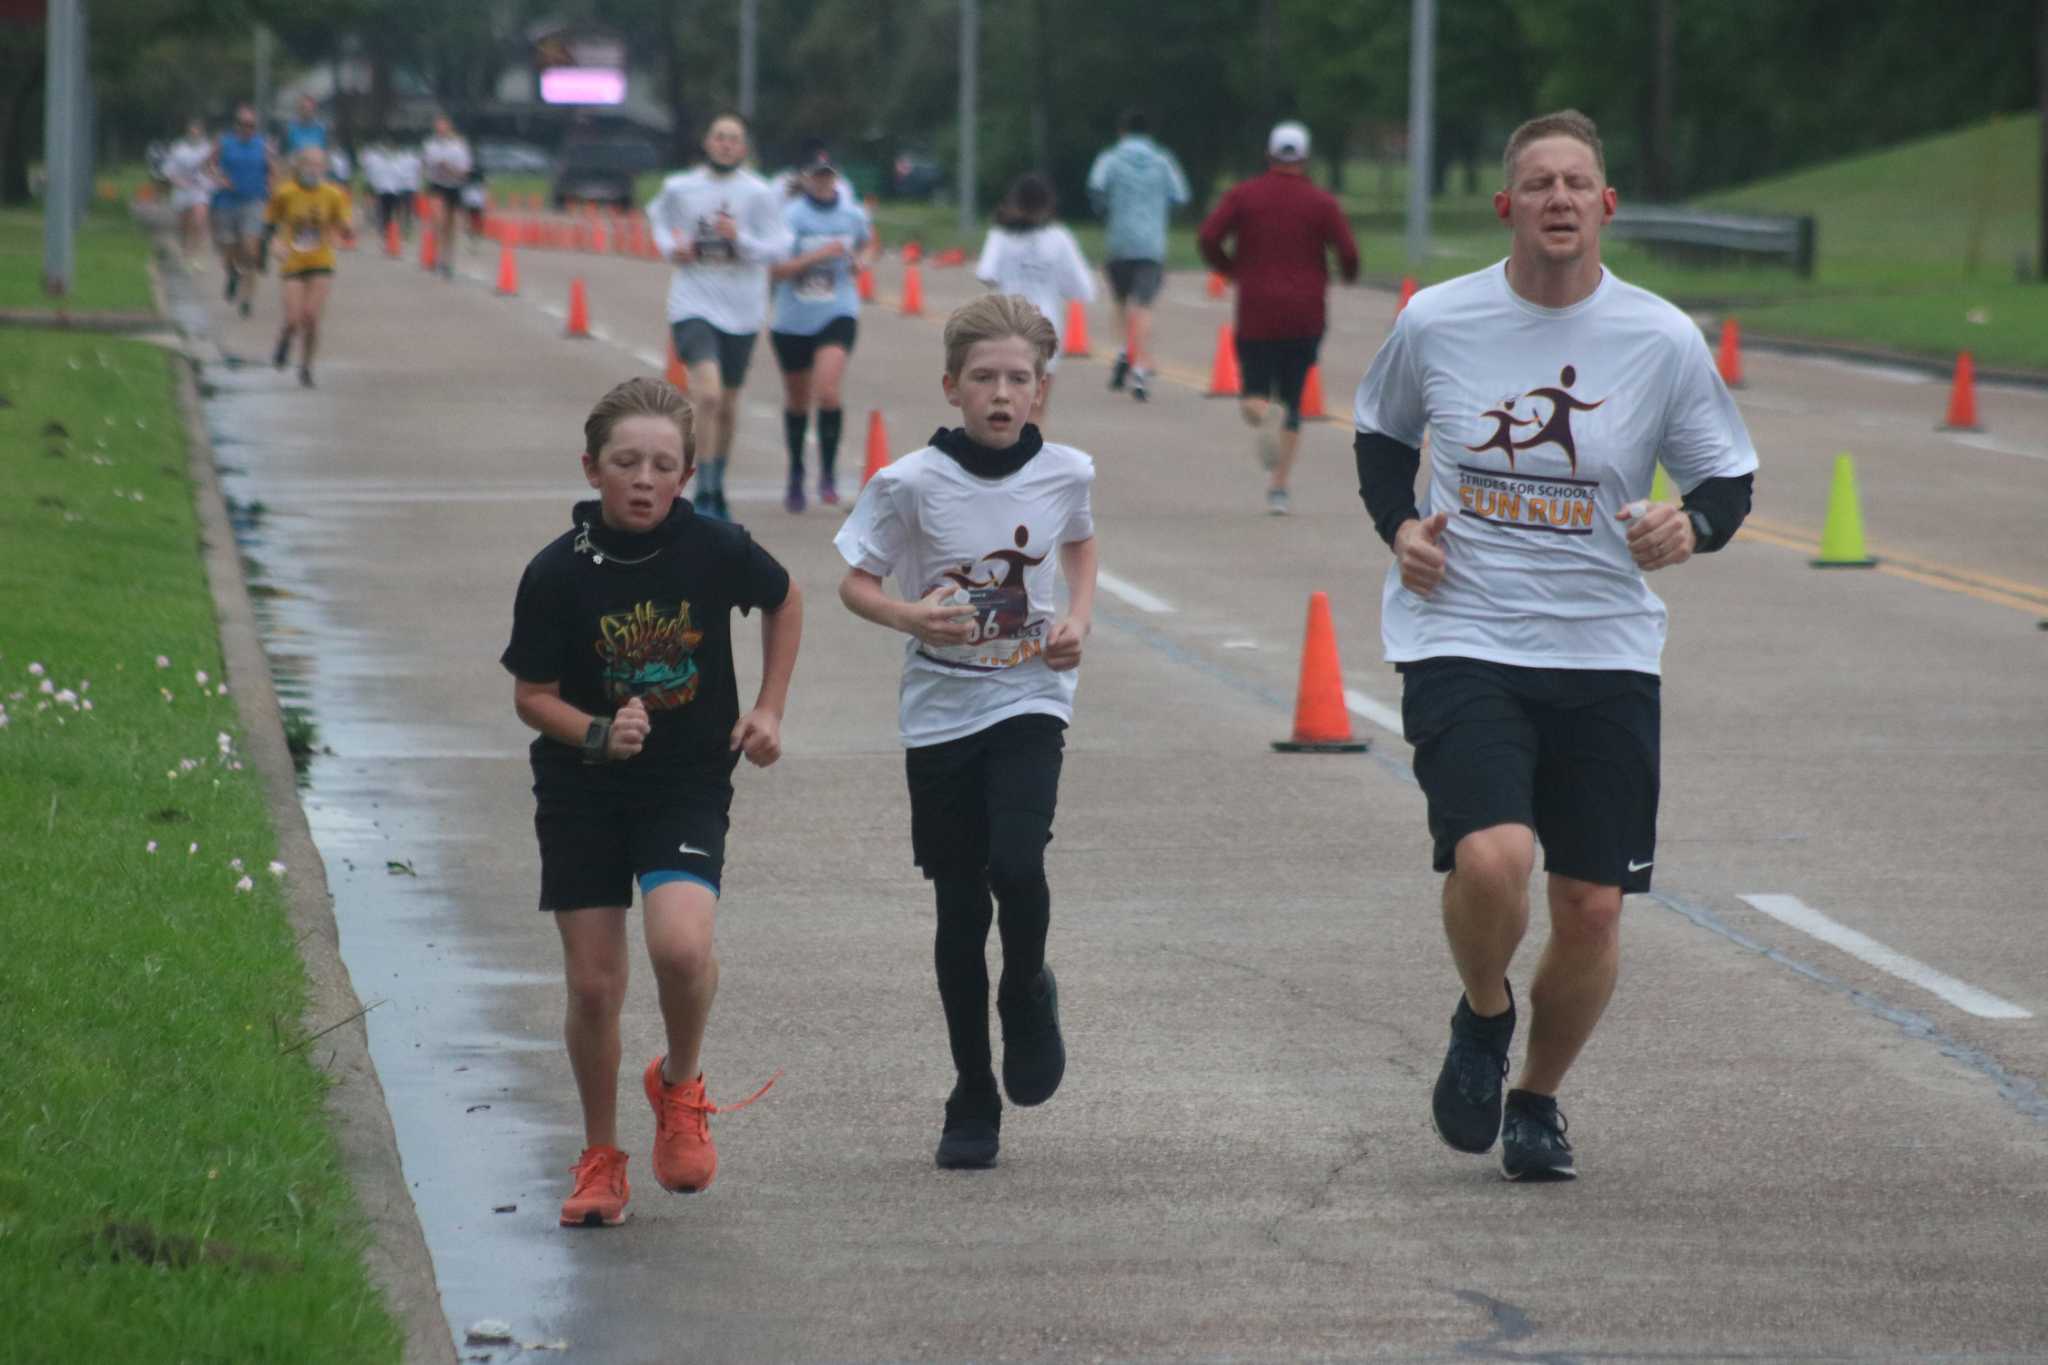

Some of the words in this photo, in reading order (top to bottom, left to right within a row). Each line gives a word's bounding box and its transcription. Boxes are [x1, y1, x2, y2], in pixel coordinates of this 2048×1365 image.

[1459, 473, 1507, 491] STRIDES
[1509, 481, 1535, 495] FOR
[1459, 486, 1521, 521] FUN
[1528, 497, 1594, 527] RUN
